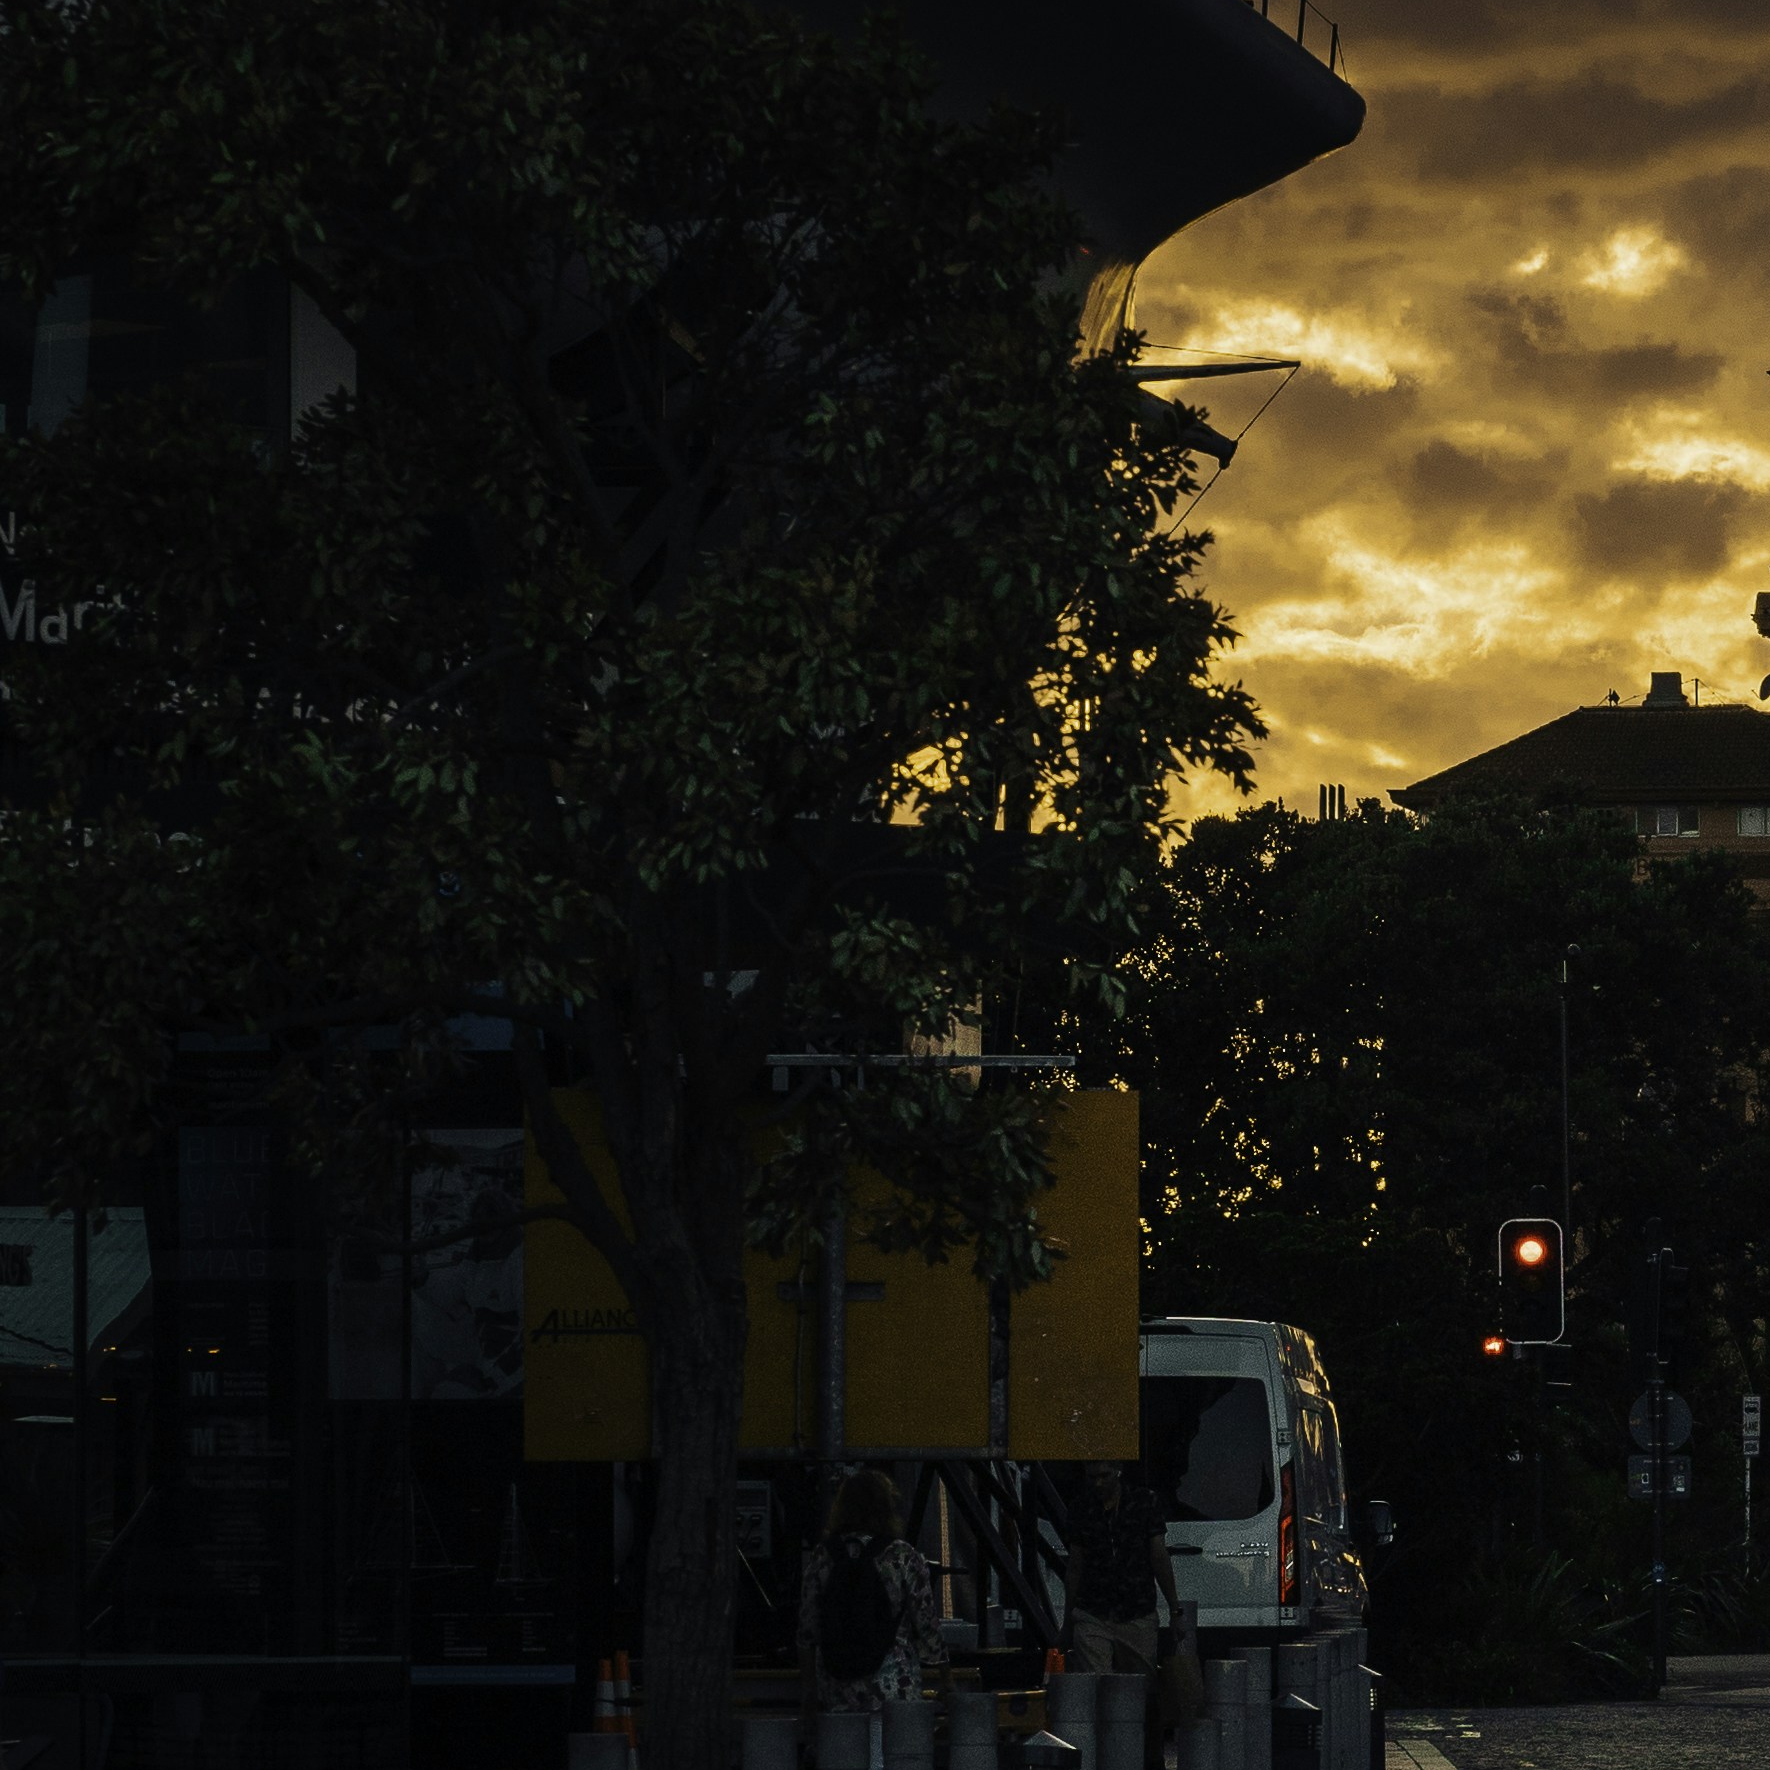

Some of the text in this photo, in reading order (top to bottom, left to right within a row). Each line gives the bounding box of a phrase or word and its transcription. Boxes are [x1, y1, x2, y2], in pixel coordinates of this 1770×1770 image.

[186, 1134, 270, 1164] BLUE
[185, 1173, 261, 1201] WAT
[187, 1249, 267, 1278] MAG
[531, 1308, 638, 1343] ALLIANC
[191, 1371, 215, 1397] M
